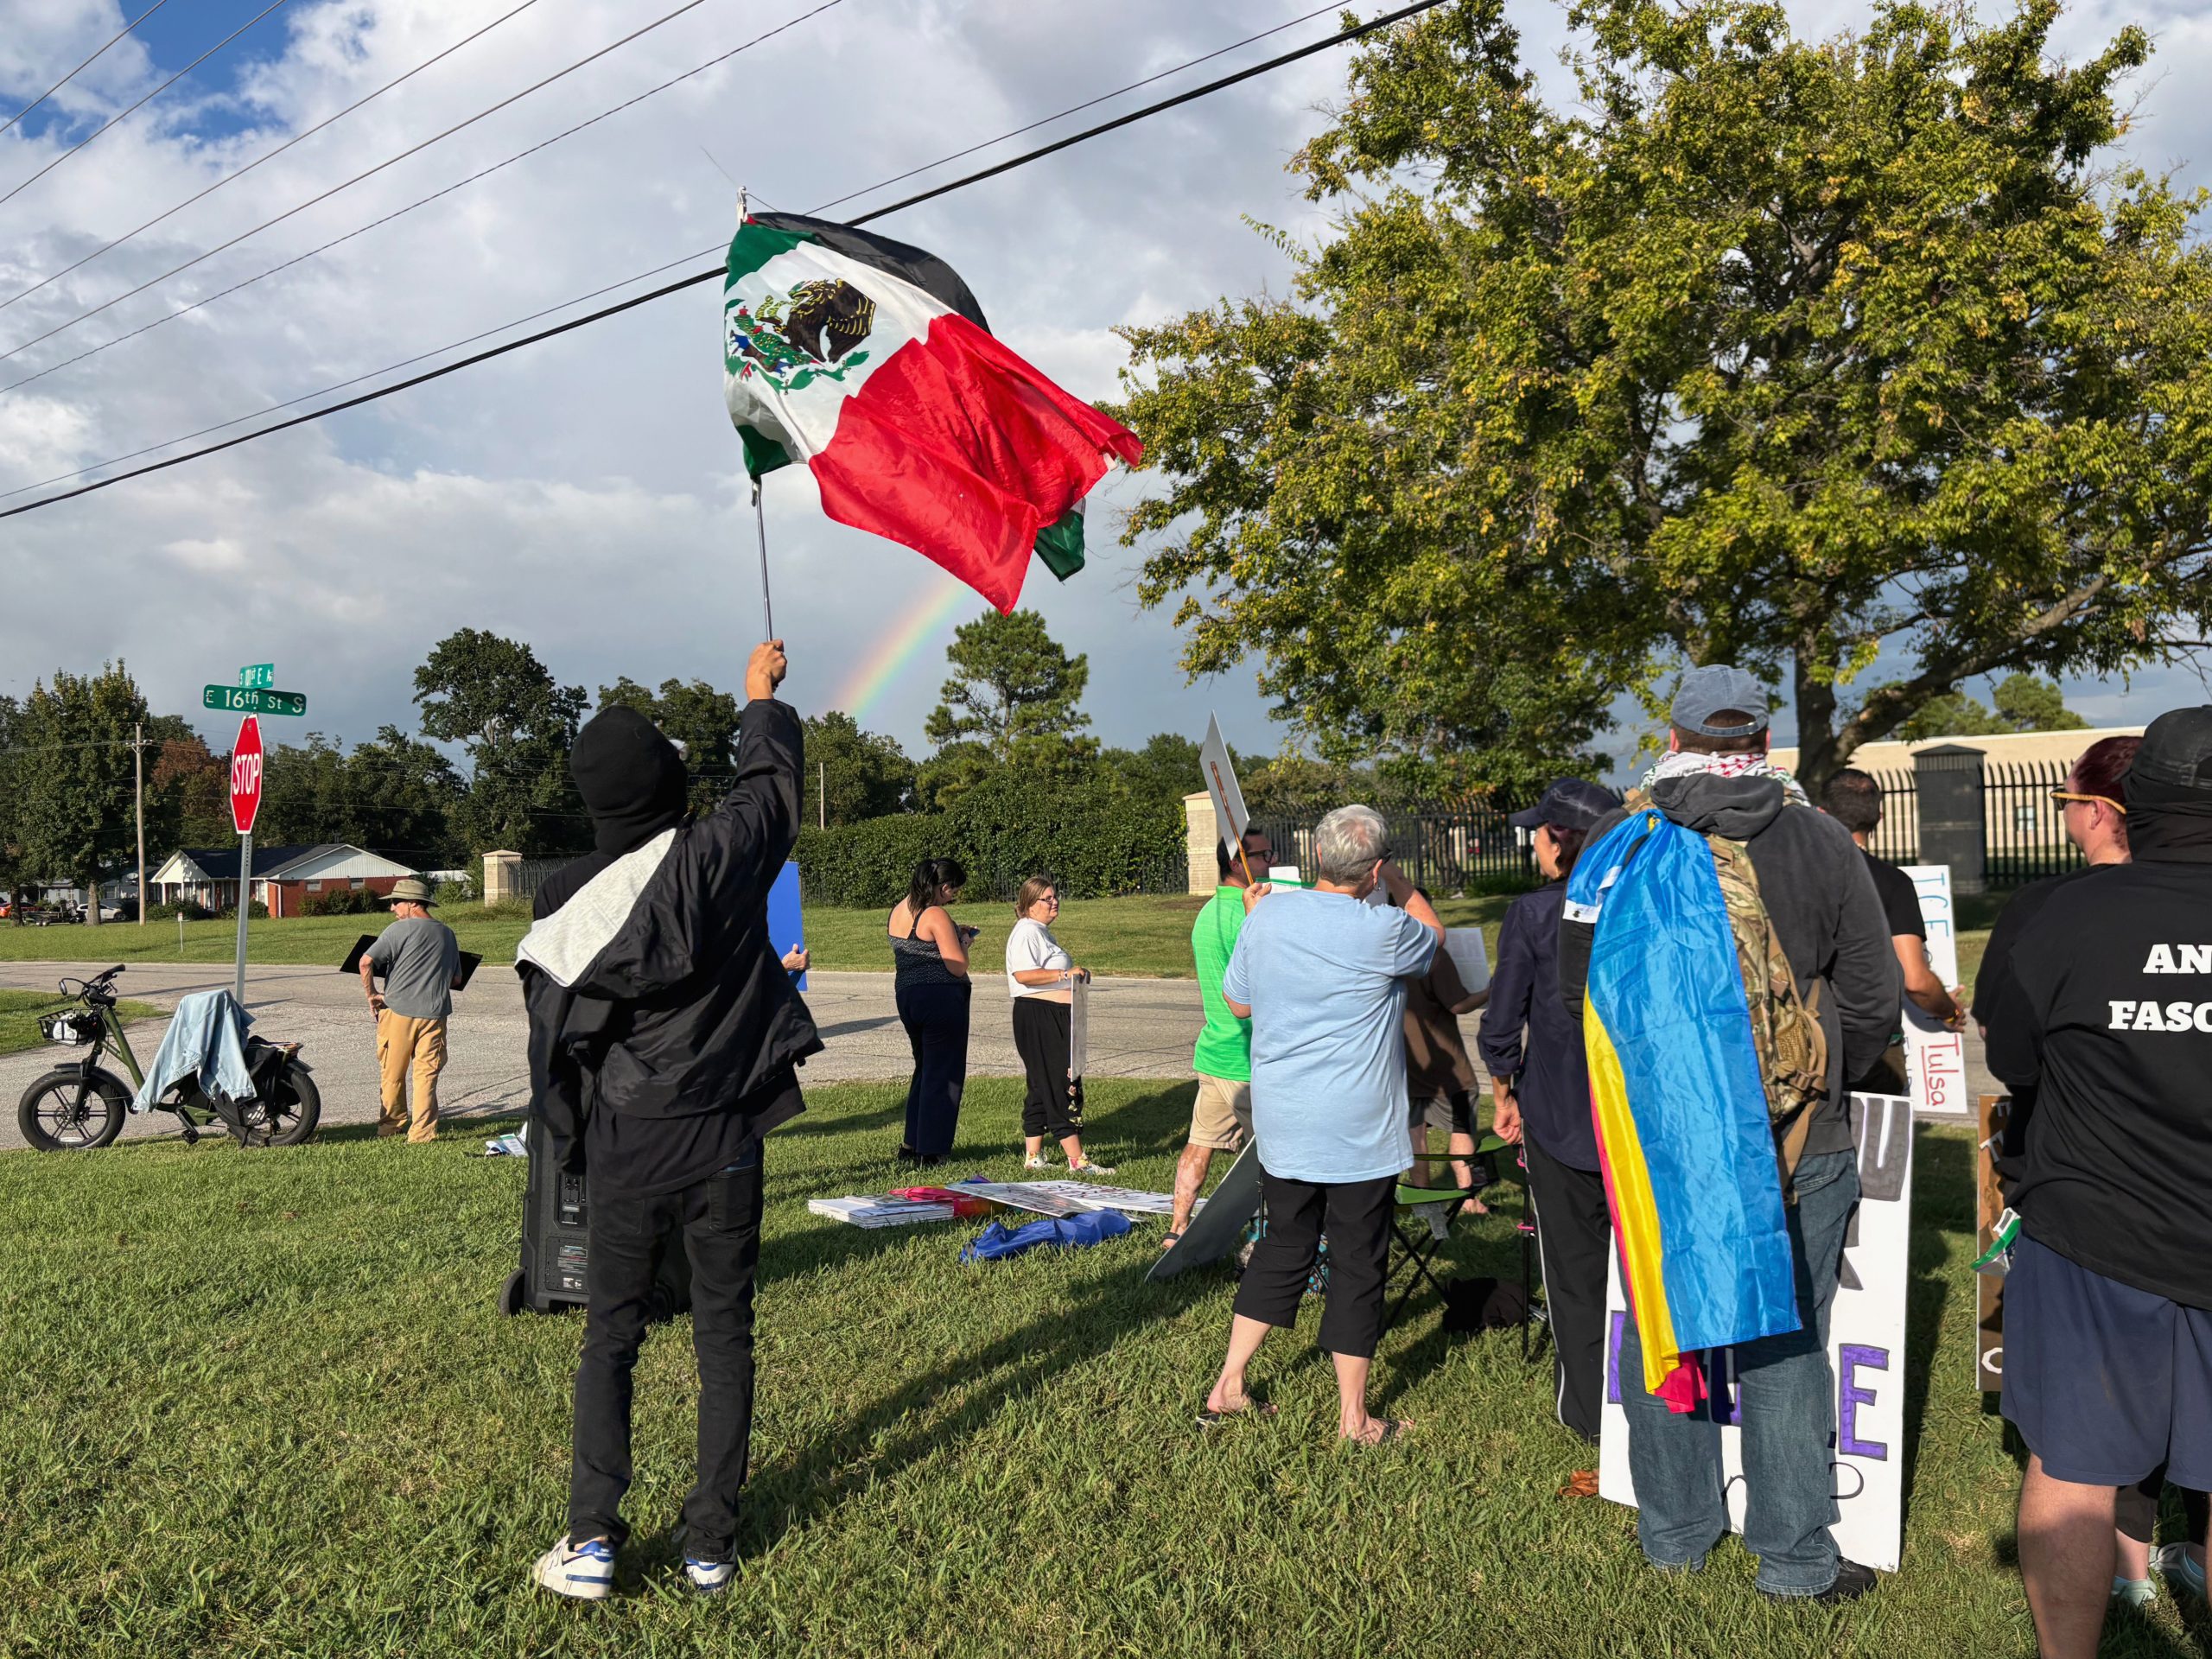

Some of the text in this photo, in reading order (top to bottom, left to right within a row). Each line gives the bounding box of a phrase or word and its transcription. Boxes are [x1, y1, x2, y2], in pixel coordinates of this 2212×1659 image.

[257, 667, 263, 684] E
[206, 690, 304, 713] E 16th St S
[233, 753, 260, 795] STOP
[1928, 1034, 1960, 1106] Tulsa
